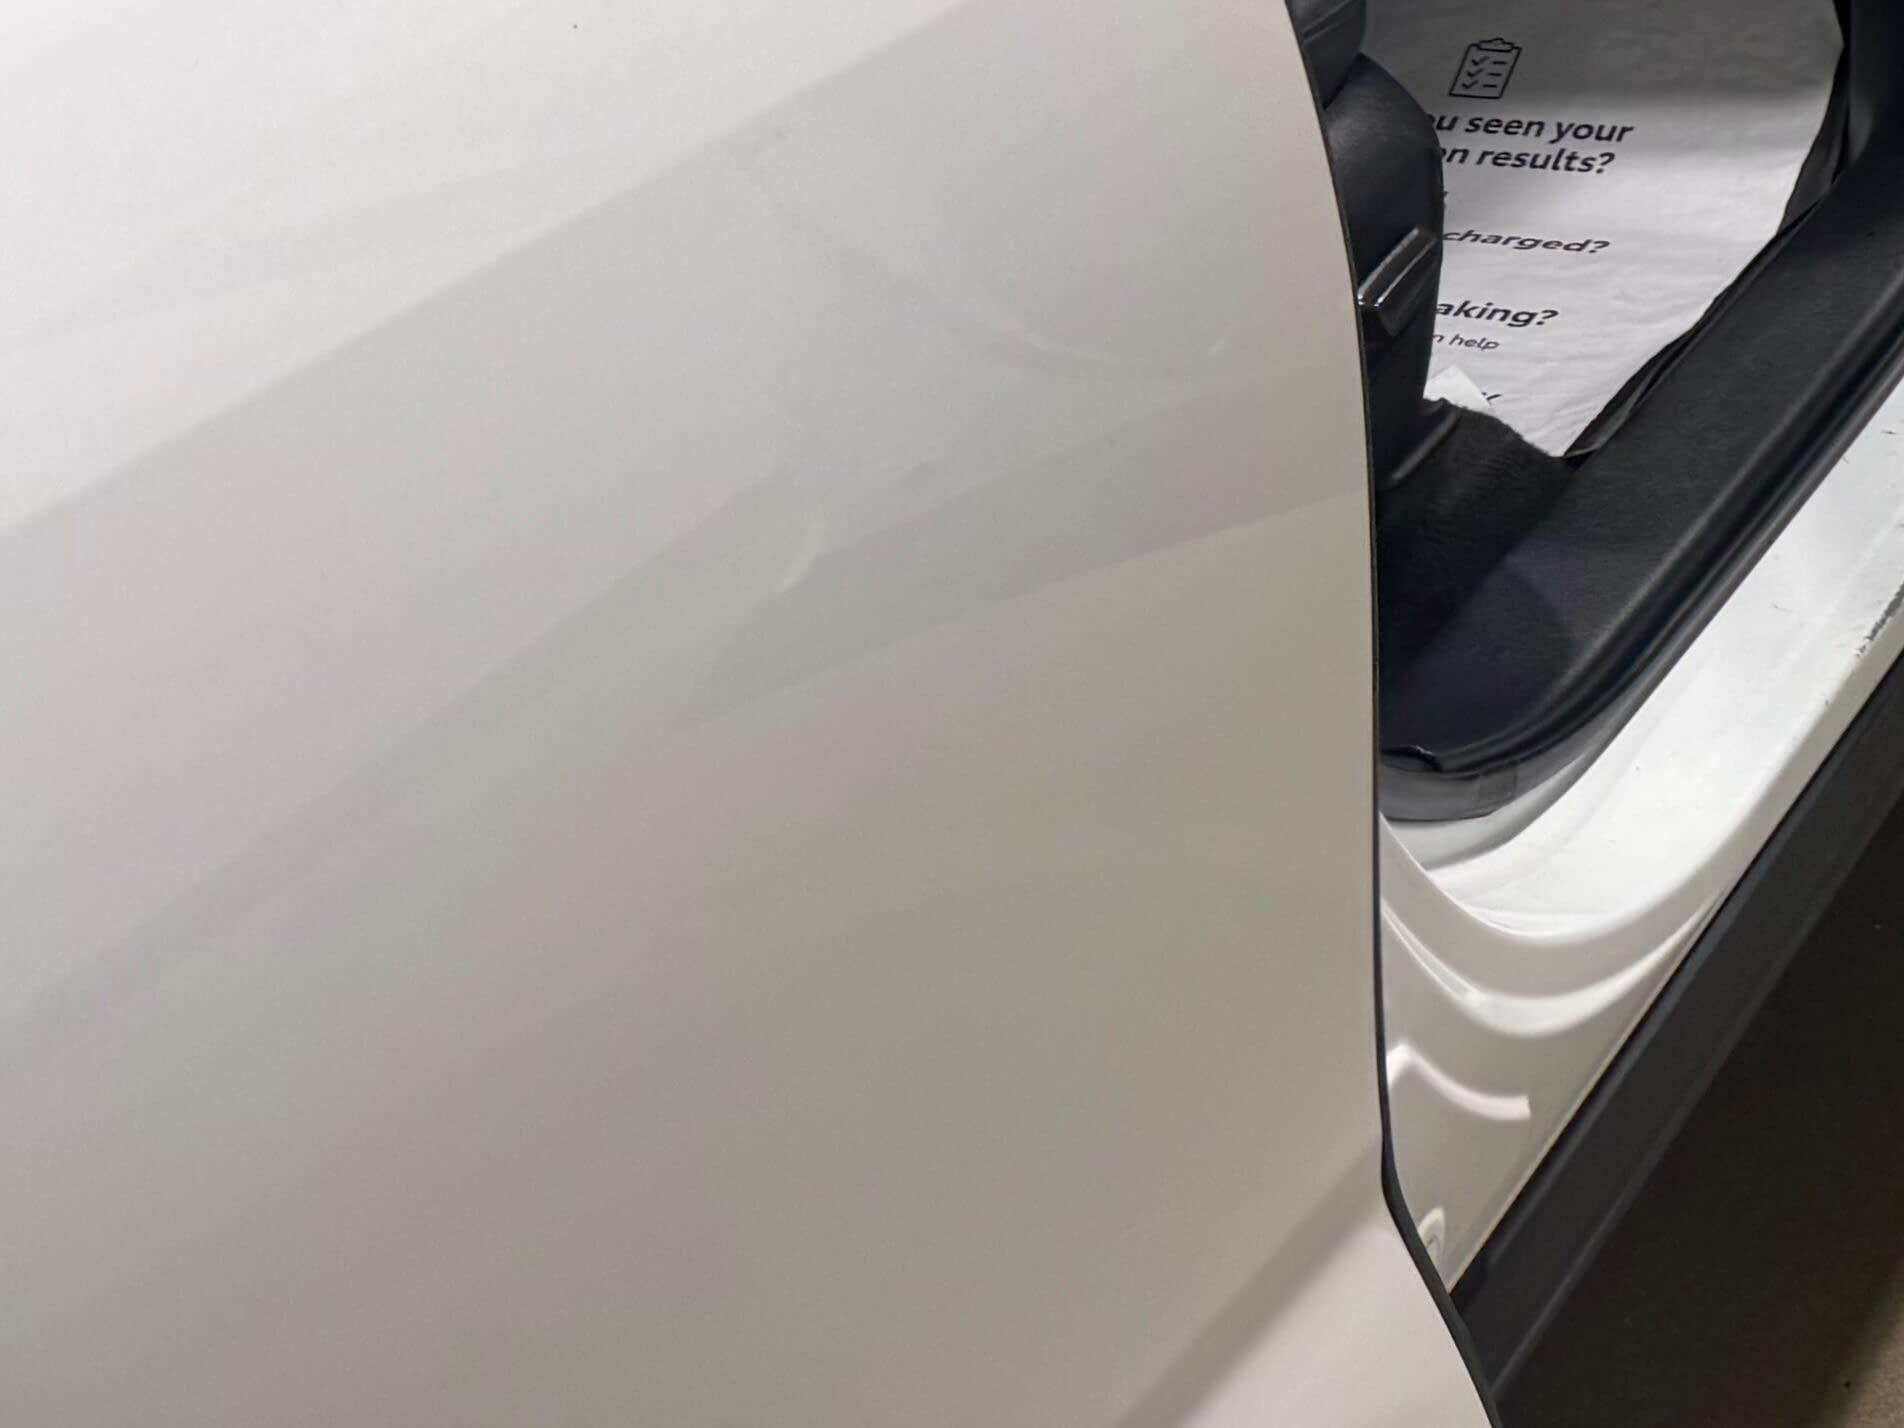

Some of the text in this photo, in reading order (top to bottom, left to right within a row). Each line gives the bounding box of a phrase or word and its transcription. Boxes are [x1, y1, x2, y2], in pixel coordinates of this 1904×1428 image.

[1465, 114, 1546, 137] seen
[1550, 120, 1635, 145] your
[1476, 147, 1616, 175] results?
[1436, 300, 1558, 328] aking?
[1449, 334, 1500, 351] help
